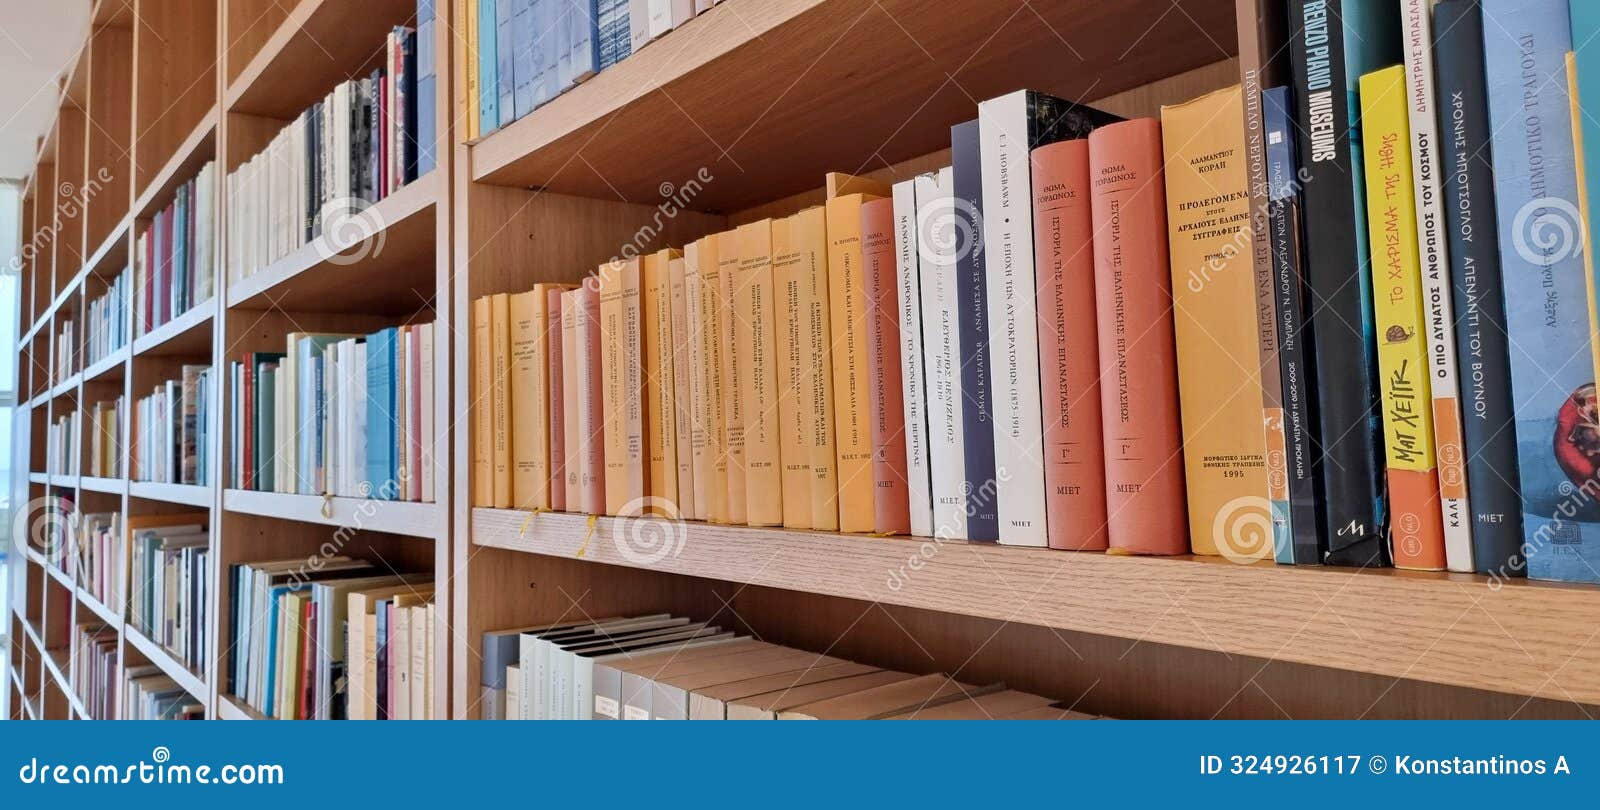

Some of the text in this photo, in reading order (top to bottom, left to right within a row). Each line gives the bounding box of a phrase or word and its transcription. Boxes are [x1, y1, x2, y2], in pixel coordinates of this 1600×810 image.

[1303, 1, 1336, 163] RENZO PIANO MUSEUMS
[1412, 49, 1426, 113] ΔΗΜΗΤΡΗΣ
[1520, 33, 1539, 111] ΤΡΑΓΟΥΔΙ
[1102, 165, 1126, 175] ΘΩΜΑ
[1190, 150, 1234, 165] ΑΔΑΜΑΝΤΙΟΥ
[1198, 161, 1226, 174] ΚΟΡΑΗ
[1249, 134, 1263, 199] ΝΕΡΟΥΔΑ
[1526, 116, 1546, 199] ΔΗΜΟΤΙΚΟ
[1043, 184, 1066, 193] ΘΩΜΑ
[1179, 191, 1249, 211] ΠΡΟΛΕΓΟΜΕΝΑ
[900, 215, 909, 262] ΜΑΝΟΛΗΣ
[1178, 212, 1250, 232] ΑΡΧΑΙΟΥΣ ΕΛΛΗΝΕ
[1193, 225, 1241, 241] ΣΥΓΓΡΑΦΕΙΣ
[1004, 243, 1012, 277] ΕΠΟΧΗ
[1256, 247, 1268, 265] ΣΕ
[1384, 206, 1402, 280] ΧΑΡΙΣΜΑ
[1418, 133, 1447, 378] Ο ΠΙΟ ΔΥΝΑΤΟΣ ΑΝΘΡΩΠΟΣ ΤΟΥ ΚΟΣΜΟΥ
[1452, 91, 1487, 420] ΧΡΟΝΗΣ ΜΠΟΤΣΟΓΛΟΥ ΑΠΕΝΑΝΤΙ ΤΟΥ ΒΟΥΝΟΥ
[1258, 270, 1270, 298] ΕΝΑ
[1279, 239, 1291, 295] ΑΛΕΞΑΝΔΡΟΥ
[903, 266, 913, 327] ΑΝΔΡΟΝΙΚΟΣ
[1005, 280, 1014, 299] ΤΩΝ
[1053, 216, 1069, 428] ΙΣΤΟΡΙΑ ΤΗΣ ΕΛΛΗΝΙΚΗΣ ΕΠΑΝΑΣΤΑΣΕΩΣ
[1111, 200, 1129, 423] ΙΣΤΟΡΙΑ ΤΗΣ ΕΛΛΗΝΙΚΗΣ ΕΠΑΝΑΣΤΑΣΕΩΣ
[1260, 303, 1274, 352] ΑΣΤΕΡΙ
[1007, 304, 1017, 385] ΑΥΤΟΚΡΑΤΟΡΙΩΝ
[1284, 310, 1294, 351] ΤΟΜΠΑΖΗ
[1392, 430, 1424, 463] ΜΑΤ
[1057, 486, 1081, 495] ΜΙΕΤ
[1116, 484, 1142, 493] ΜΙΕΤ
[1223, 470, 1244, 478] 1995
[1011, 520, 1031, 528] ΜΙΕΤ
[1478, 514, 1504, 523] ΜΙΕΤ
